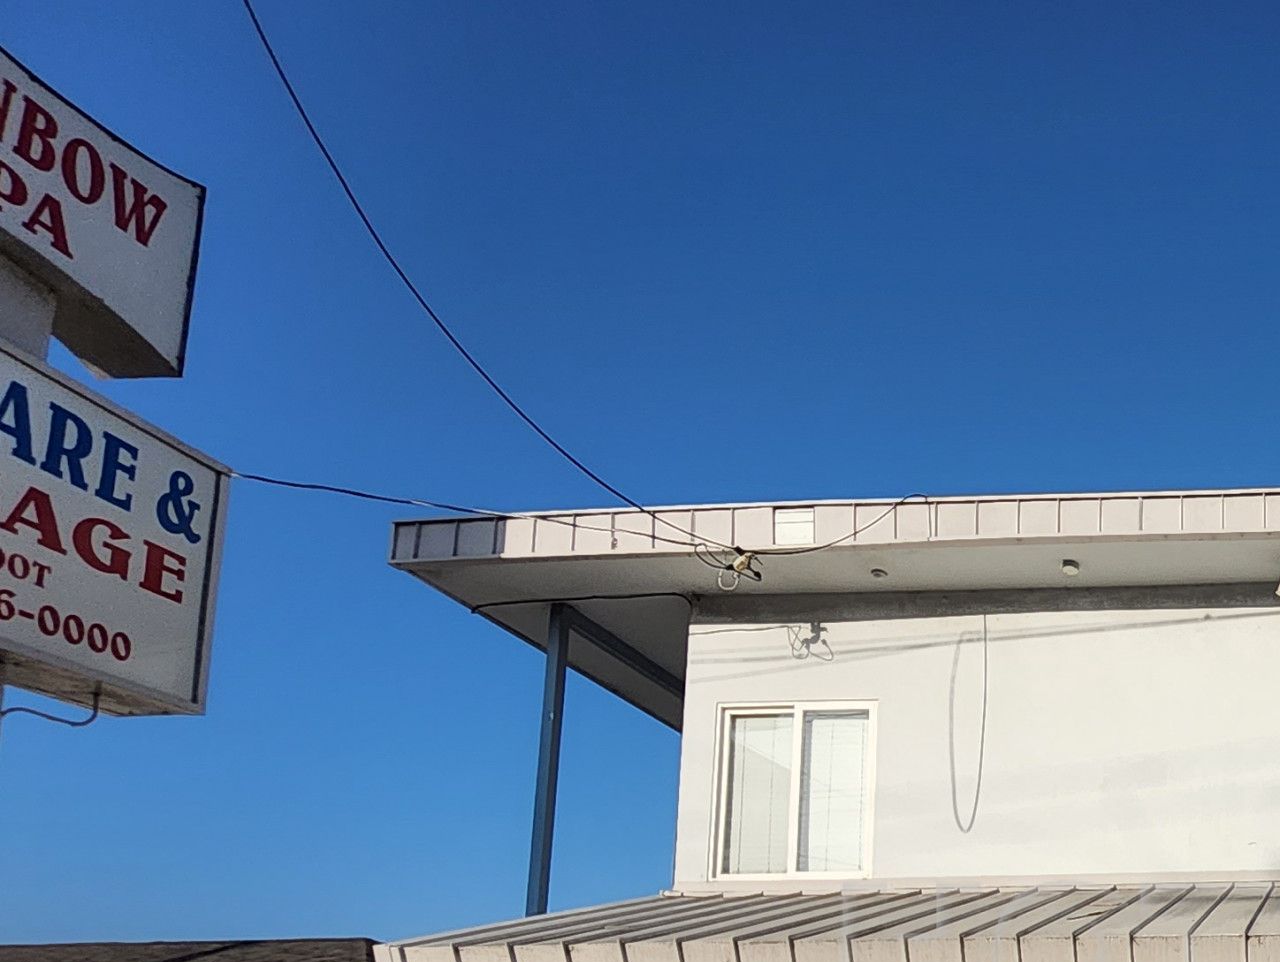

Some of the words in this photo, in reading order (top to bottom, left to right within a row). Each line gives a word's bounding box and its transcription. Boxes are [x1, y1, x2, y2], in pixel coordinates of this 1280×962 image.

[0, 380, 139, 512] ARE
[157, 470, 201, 544] &
[0, 486, 187, 604] AGE
[0, 553, 51, 588] OT
